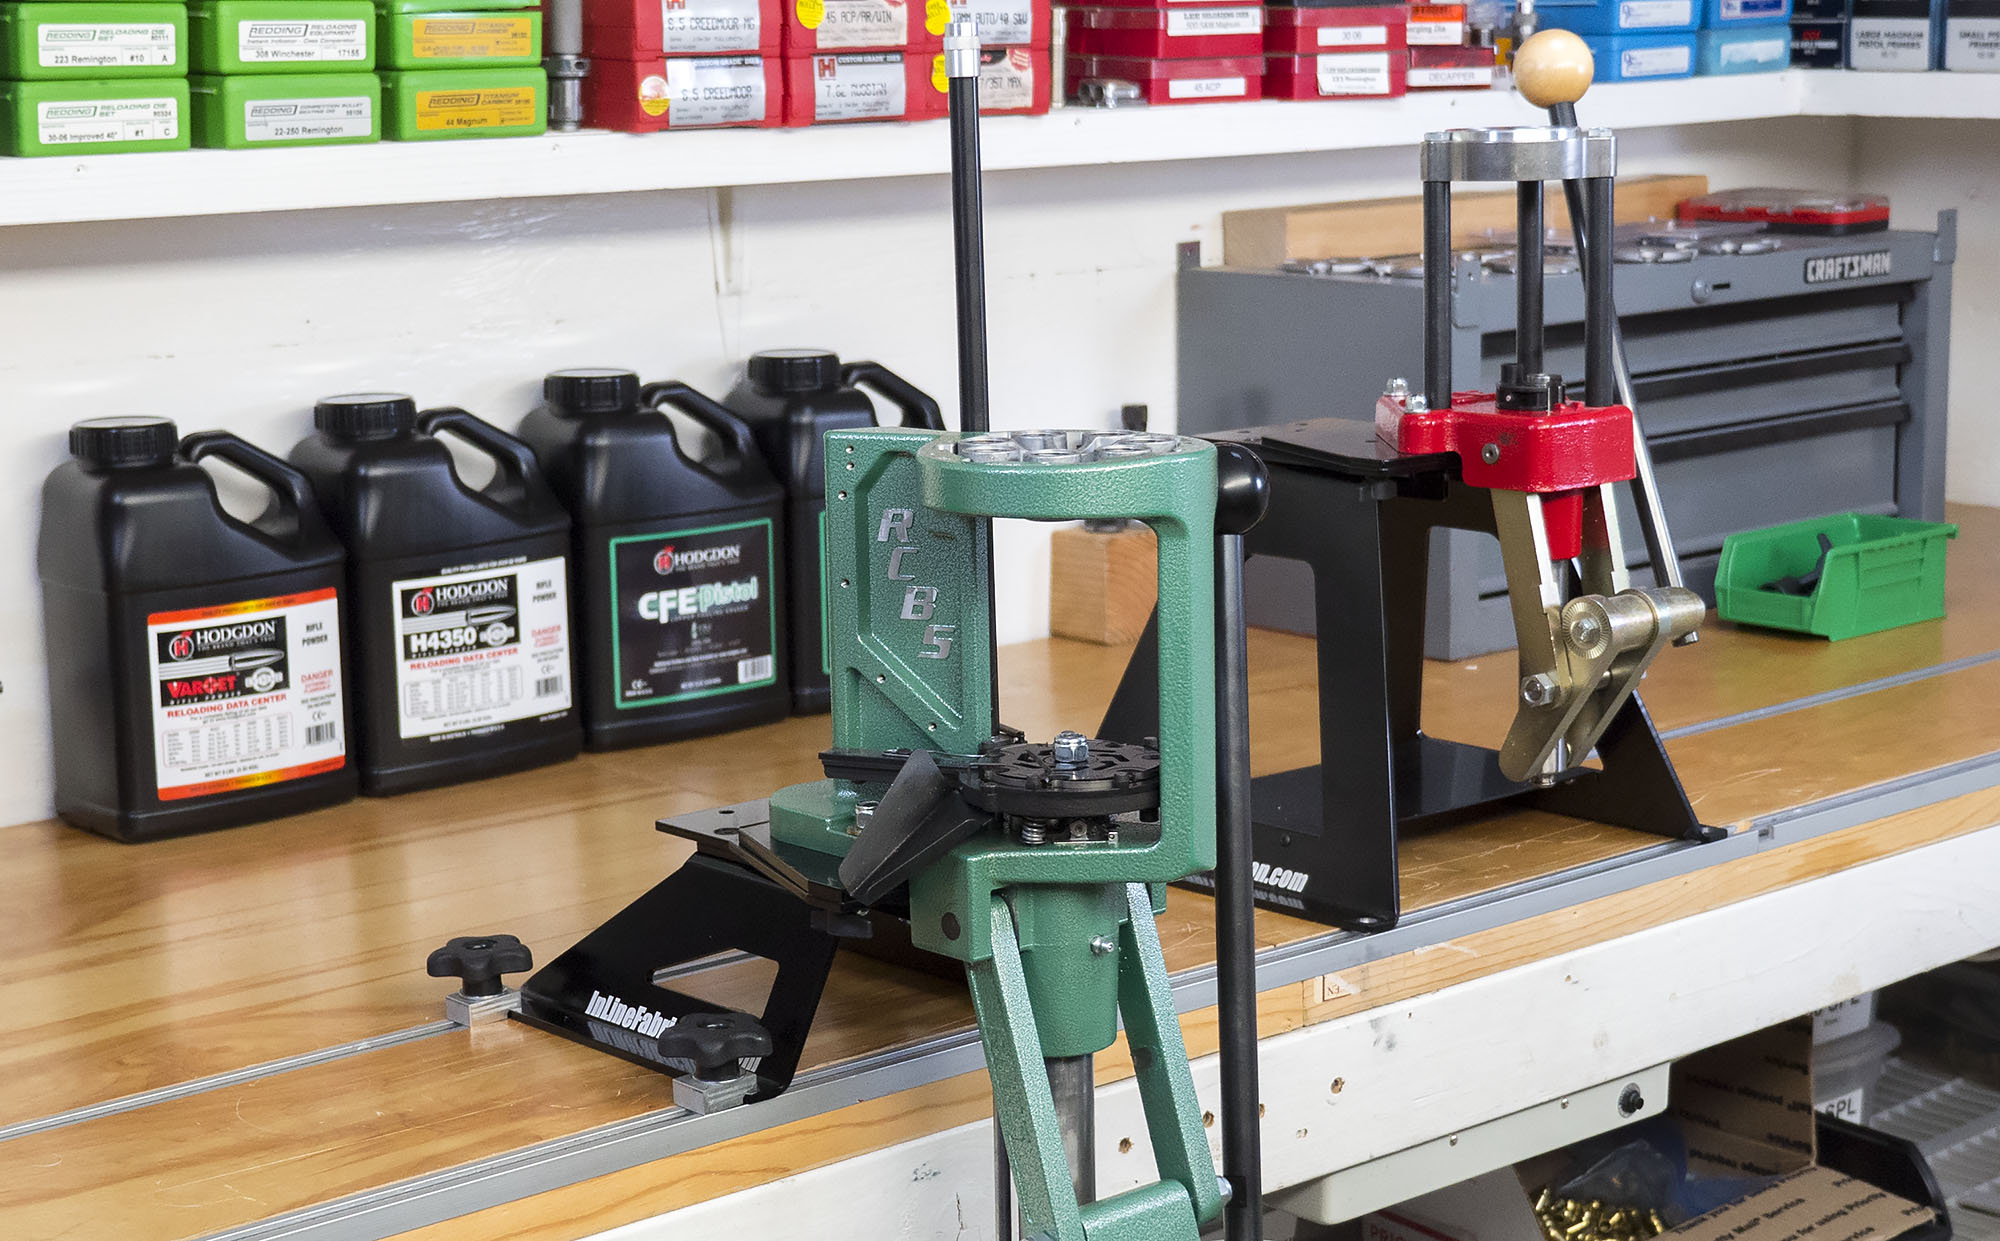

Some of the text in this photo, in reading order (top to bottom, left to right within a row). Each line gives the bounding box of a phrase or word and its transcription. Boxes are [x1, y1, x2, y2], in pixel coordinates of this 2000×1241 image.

[826, 11, 837, 24] 45
[689, 17, 740, 31] CREEDMOOR
[47, 31, 92, 40] REDDING
[250, 27, 303, 35] REDDING
[1886, 41, 1921, 49] PRIMERS
[271, 49, 315, 58] Winchester
[54, 55, 70, 64] 223
[71, 54, 118, 66] Remington
[161, 54, 168, 62] A
[1428, 72, 1475, 81] DECAPPER
[430, 97, 475, 105] REDDING
[47, 107, 92, 117] REDDING
[100, 103, 151, 111] RELOADING
[251, 107, 293, 116] REDDING
[456, 118, 488, 127] Magnum
[69, 131, 105, 142] Improved
[163, 128, 171, 136] C
[274, 126, 344, 136] 22-250 Remington
[1806, 250, 1891, 283] CRAFTSMAN
[674, 545, 741, 565] HODGDON
[436, 579, 509, 601] HODGDON
[535, 579, 552, 590] RIFLE
[532, 591, 557, 603] POWDER
[638, 586, 698, 624] CFE
[195, 620, 276, 645] HODGDON
[305, 622, 323, 633] RIFLE
[302, 634, 328, 647] POWDER
[410, 626, 477, 653] H4350
[410, 657, 461, 670] RELOADING
[463, 654, 484, 663] DATA
[486, 647, 518, 658] CENTER
[301, 669, 333, 684] DANGER
[167, 693, 287, 718] RELOADING DATA CENTER
